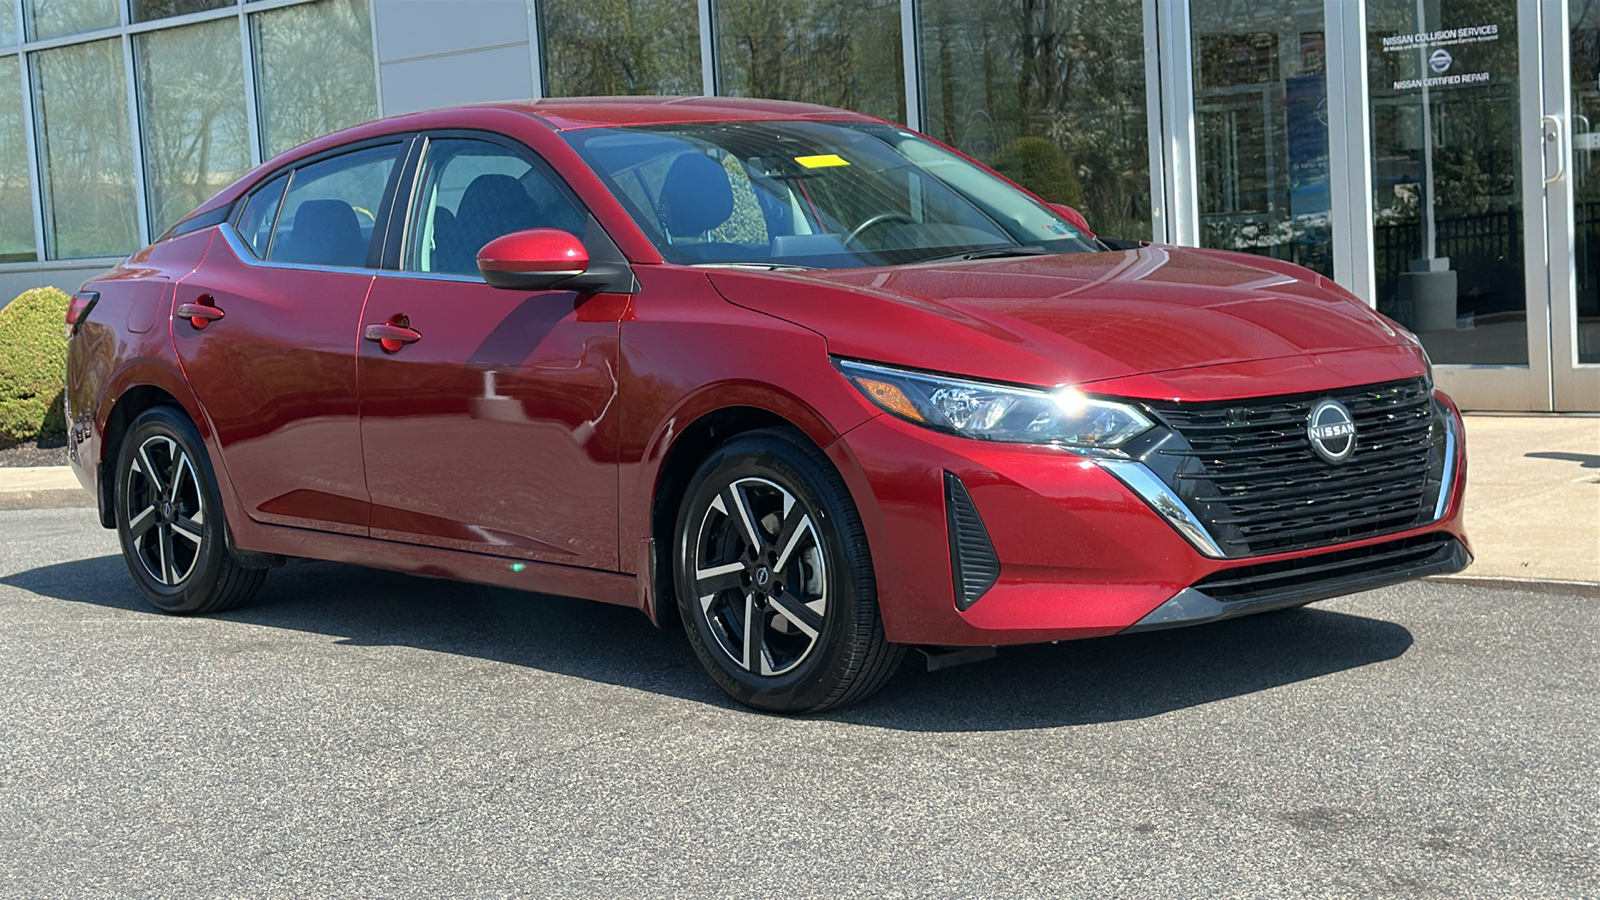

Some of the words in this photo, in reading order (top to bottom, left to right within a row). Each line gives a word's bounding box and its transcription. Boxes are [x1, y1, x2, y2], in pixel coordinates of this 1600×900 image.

[1383, 35, 1413, 46] NISSAN
[1415, 29, 1457, 41] COLLISION
[1458, 25, 1498, 37] SERVICES
[1393, 79, 1422, 90] NISSAN
[1423, 75, 1461, 87] CERTIFIED
[1462, 72, 1489, 83] REPAIR
[1310, 424, 1354, 438] NISSAN
